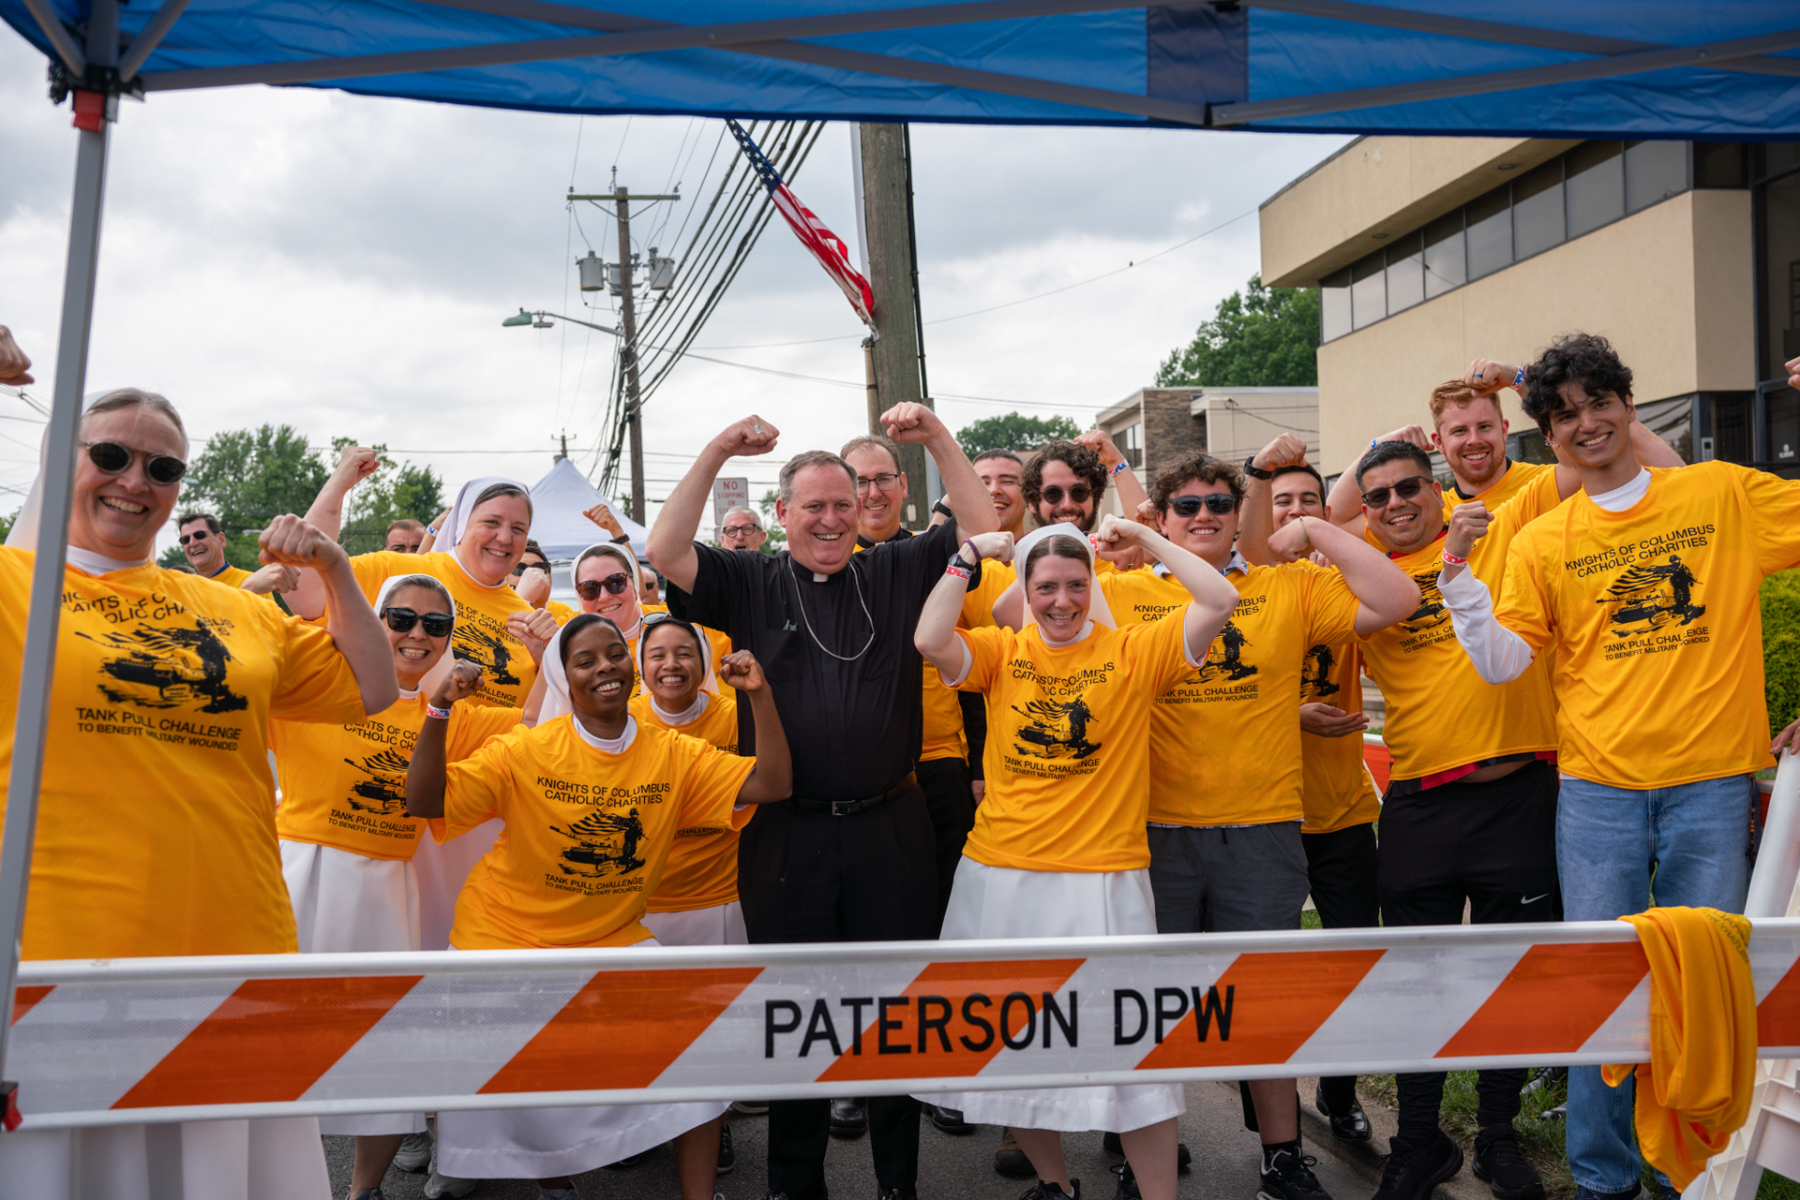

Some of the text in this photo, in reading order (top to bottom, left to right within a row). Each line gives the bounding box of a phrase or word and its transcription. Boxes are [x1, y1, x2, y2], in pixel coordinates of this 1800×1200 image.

[723, 481, 738, 490] NO
[1565, 524, 1715, 571] KNIGHTS OF COLUMBUS
[1577, 537, 1708, 578] CATHOLIC CHARITIES
[466, 606, 478, 615] OF
[1134, 604, 1182, 613] KNIGHT
[456, 608, 524, 647] OLIC CHARITIES
[1399, 631, 1441, 648] TANK PULL
[1434, 632, 1456, 643] MILITA
[1604, 642, 1626, 653] TANK
[1629, 638, 1654, 649] PULL
[1614, 649, 1642, 659] BENEFIT
[1645, 644, 1678, 654] MILITARY
[1680, 636, 1710, 645] ONDED
[1047, 676, 1060, 685] OF
[480, 686, 518, 703] ALLENGE
[1164, 697, 1191, 705] BENEFIT
[1193, 696, 1223, 704] MILITARY
[1225, 693, 1258, 701] WOUNDED
[1178, 689, 1202, 697] PULL
[1204, 684, 1258, 696] CHALLENGE
[76, 708, 242, 740] TANK PULL CHALLENGE
[387, 725, 400, 736] OF
[77, 723, 94, 732] TO
[97, 724, 143, 736] BENEFIT
[189, 737, 238, 751] WOUNDED
[1004, 755, 1022, 767] TANK
[1024, 761, 1046, 771] PULL
[1012, 766, 1036, 776] BENEFIT
[1037, 772, 1066, 780] MILITARY
[1068, 767, 1098, 777] OUNDE
[537, 775, 671, 799] KNIGHTS OF COLUMBUS
[545, 789, 663, 808] CATHOLIC CHARITIES
[331, 809, 417, 832] TANK PULL CHALLENGE
[339, 820, 367, 833] BENEFIT
[368, 828, 393, 838] MILITARY
[678, 827, 715, 836] CHALLE
[545, 873, 644, 890] TANK PULL CHALLENGE
[555, 884, 583, 894] BENEFIT
[583, 889, 611, 897] MILITARY
[612, 885, 643, 895] WOUNDED
[764, 984, 1235, 1059] PATERSON DPW
